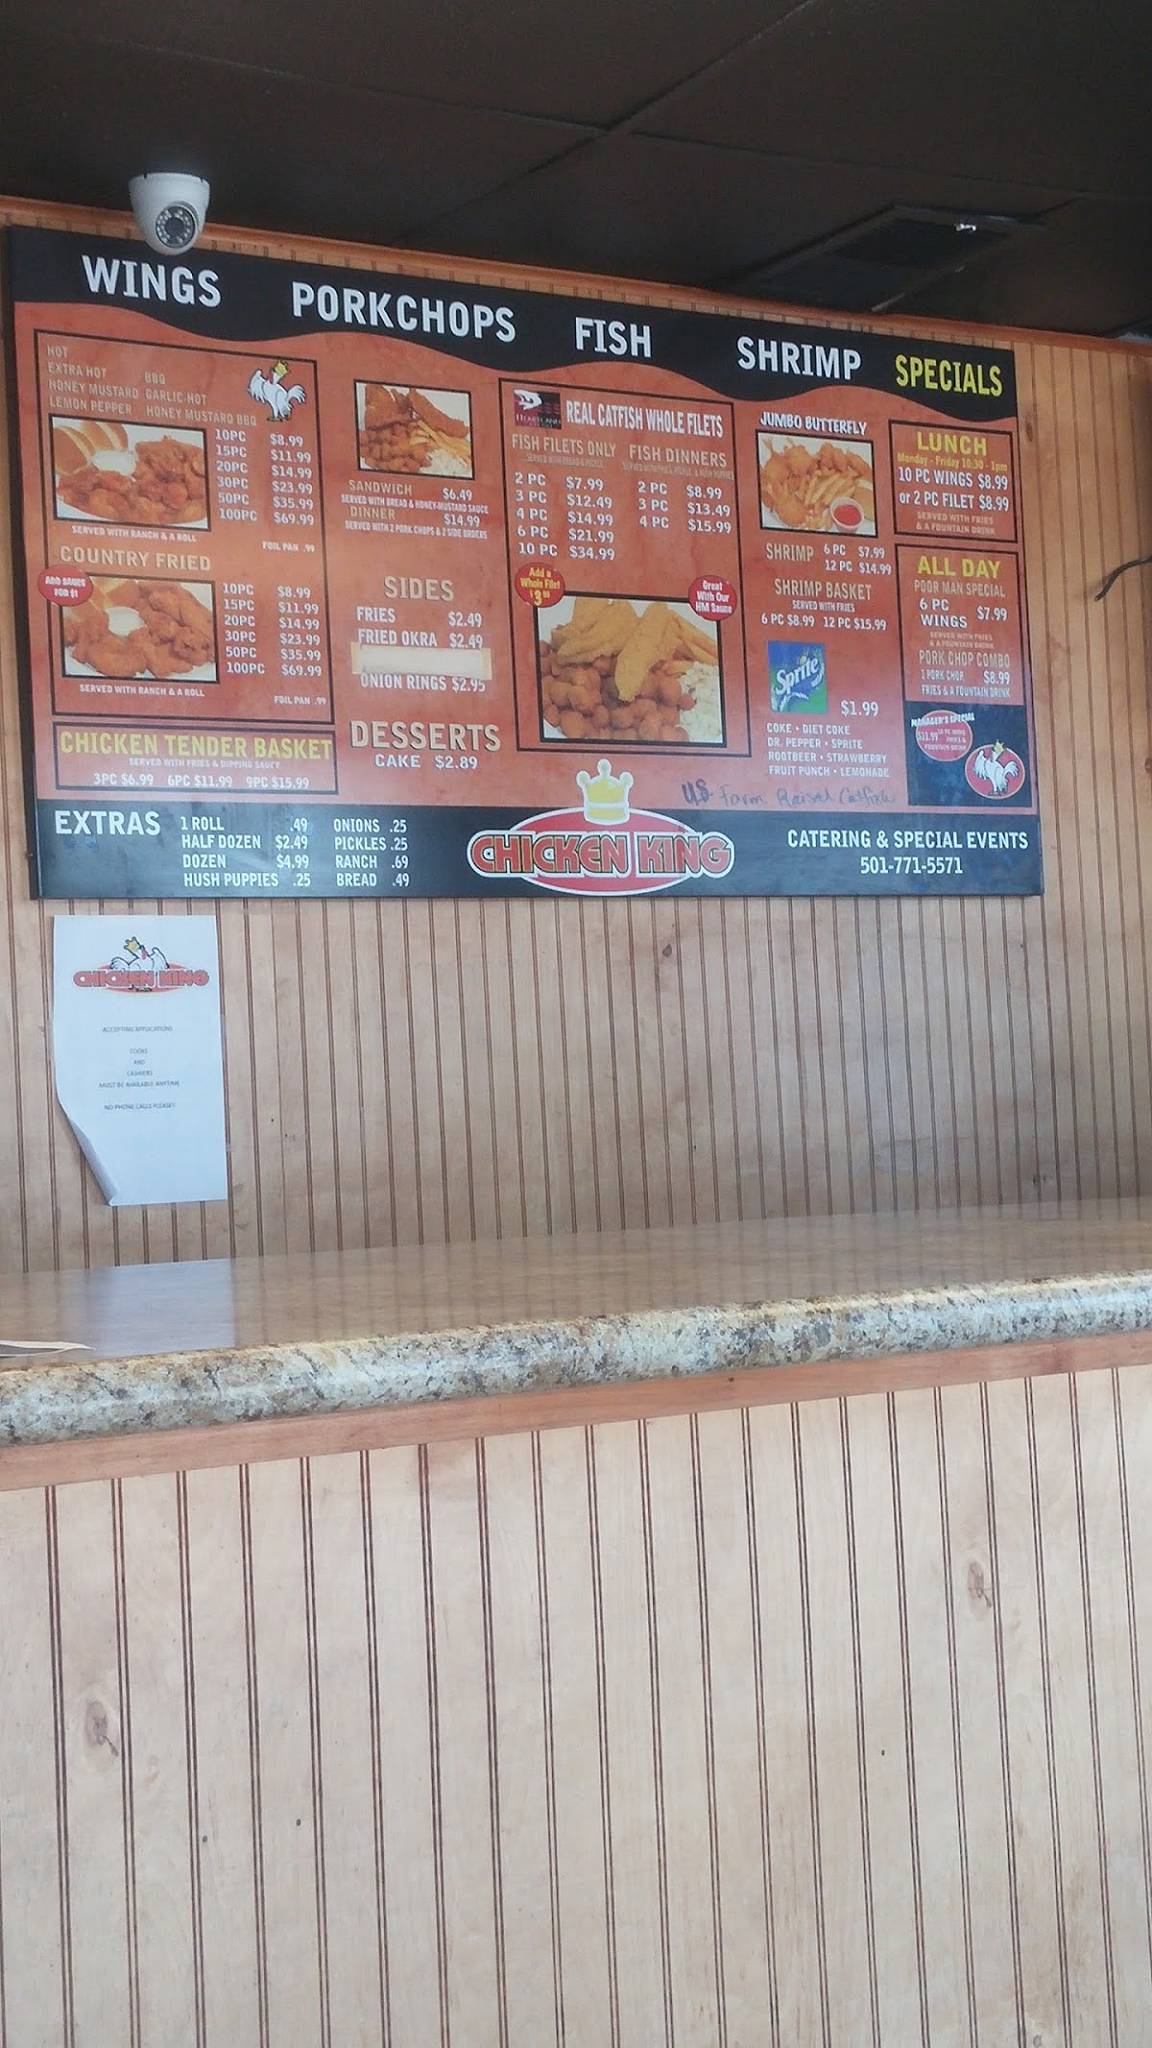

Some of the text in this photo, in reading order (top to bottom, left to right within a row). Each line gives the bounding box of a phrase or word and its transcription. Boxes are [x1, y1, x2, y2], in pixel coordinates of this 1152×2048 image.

[81, 255, 222, 307] WINGS
[291, 281, 516, 342] PORKCHOPS
[575, 316, 652, 358] FISH
[737, 336, 861, 380] SHRIMP
[48, 363, 107, 378] EXTRA HOT
[895, 354, 1003, 397] SPECIALS
[48, 380, 139, 400] HONEY MUSTARD
[50, 396, 132, 416] LEMON PEPPER
[146, 407, 257, 427] HONEY MUSTARD BBQ
[566, 401, 723, 438] REAL CATFISH WHOLE FILETS
[760, 411, 867, 436] JUMBO BUTTERFLY
[215, 429, 304, 447] 10PC $8.99
[512, 434, 616, 457] FISH FILETS ONLY
[917, 431, 987, 456] LUNCH
[216, 445, 311, 463] 15PC $11.99
[629, 444, 661, 462] FISH
[665, 448, 727, 468] DINNERS
[216, 460, 312, 479] 20PC $14.99
[898, 466, 1008, 491] 10 PC WINGS $8.99
[217, 476, 313, 495] 30PC $23.99
[348, 479, 472, 501] SANDWICH $6.49
[515, 472, 604, 491] 2 PC $7.99
[638, 481, 722, 499] 2 PC $8.99
[218, 492, 313, 511] 50PC $35.99
[515, 490, 612, 509] 3 PC $12.49
[899, 490, 1009, 511] or 2 PC FILET $8.99
[219, 508, 314, 526] 100PC $69.99
[350, 506, 480, 527] DINNER $14.99
[60, 545, 211, 571] COUNTRY FRIED
[766, 543, 885, 562] SHRIMP 6 PC $7.99
[918, 555, 1001, 579] ALL DAY
[384, 576, 454, 602] SIDES
[775, 578, 871, 600] SHRIMP BASKET
[914, 579, 1005, 598] POOR MAN SPECIAL
[356, 606, 482, 628] FRIES $2.49
[919, 598, 1008, 621] 6 PC $7.99
[920, 614, 968, 629] WINGS
[358, 629, 483, 649] FRIED OKRA $2.49
[919, 650, 1010, 668] PORK CHOP COMBO
[360, 673, 402, 689] ONION
[407, 675, 447, 690] RINGS
[776, 656, 819, 695] Sprite
[841, 700, 879, 717] $1.99
[351, 720, 501, 752] DESSERTS
[767, 723, 850, 735] COKE DIET COKE
[60, 731, 332, 760] CHICKEN TENDER BASKET
[768, 738, 863, 749] DR. PEPPER SPRITE
[375, 754, 478, 770] CAKE $2.89
[768, 751, 887, 764] ROOTBEER STRAWBERRY
[93, 773, 154, 787] 3PC $6.99
[769, 765, 889, 778] FRUIT PUNCH LEMONADE
[167, 775, 232, 788] 6PC $11.99
[246, 776, 309, 789] 9PC $15.99
[55, 810, 160, 836] EXTRAS
[181, 816, 308, 831] 1 ROLL .49
[334, 819, 407, 833] ONIONS .25
[181, 834, 308, 850] HALF DOZEN $2.49
[334, 837, 408, 851] PICKLES .25
[788, 829, 1028, 849] CATERING & SPECIAL EVENTS
[183, 854, 309, 870] DOZEN $4.99
[335, 854, 409, 870] RANCH .69
[470, 833, 733, 876] CHICKEN KING
[860, 856, 963, 875] 501-771-5571
[184, 872, 311, 887] HUSH PUPPIES .25
[336, 873, 409, 887] BREAD .49
[73, 970, 209, 988] CHICKEN KING
